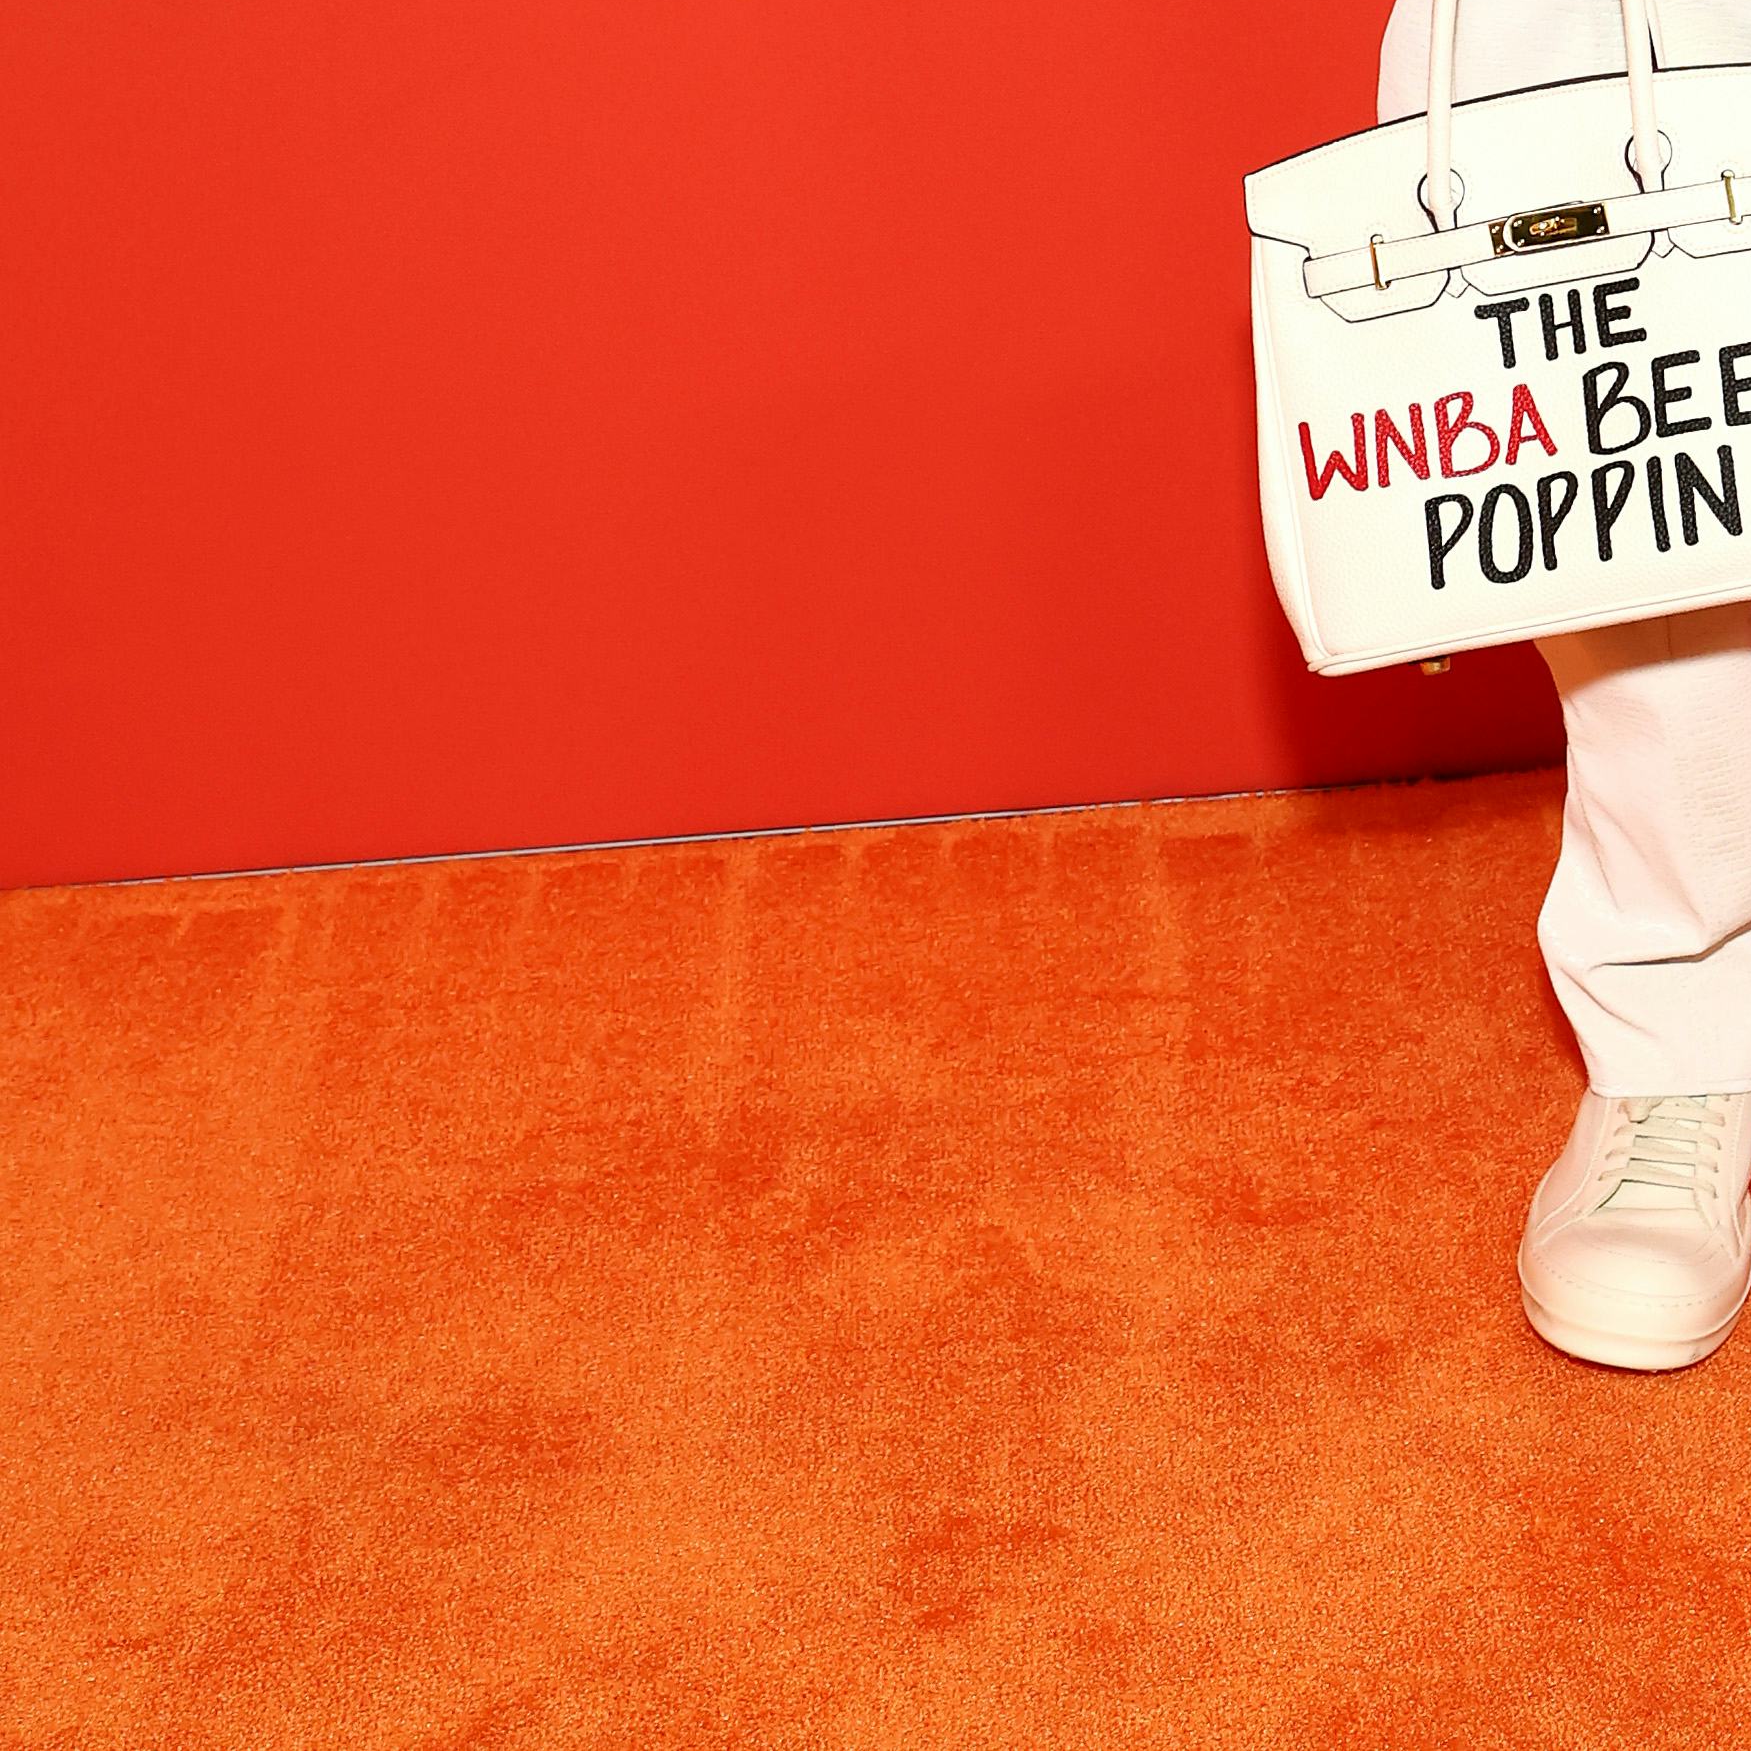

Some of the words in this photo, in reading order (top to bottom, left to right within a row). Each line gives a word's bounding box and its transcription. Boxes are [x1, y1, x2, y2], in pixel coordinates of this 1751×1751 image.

[1473, 276, 1648, 369] THE
[1297, 383, 1558, 502] WNBA
[1424, 444, 1743, 590] POPPIN
